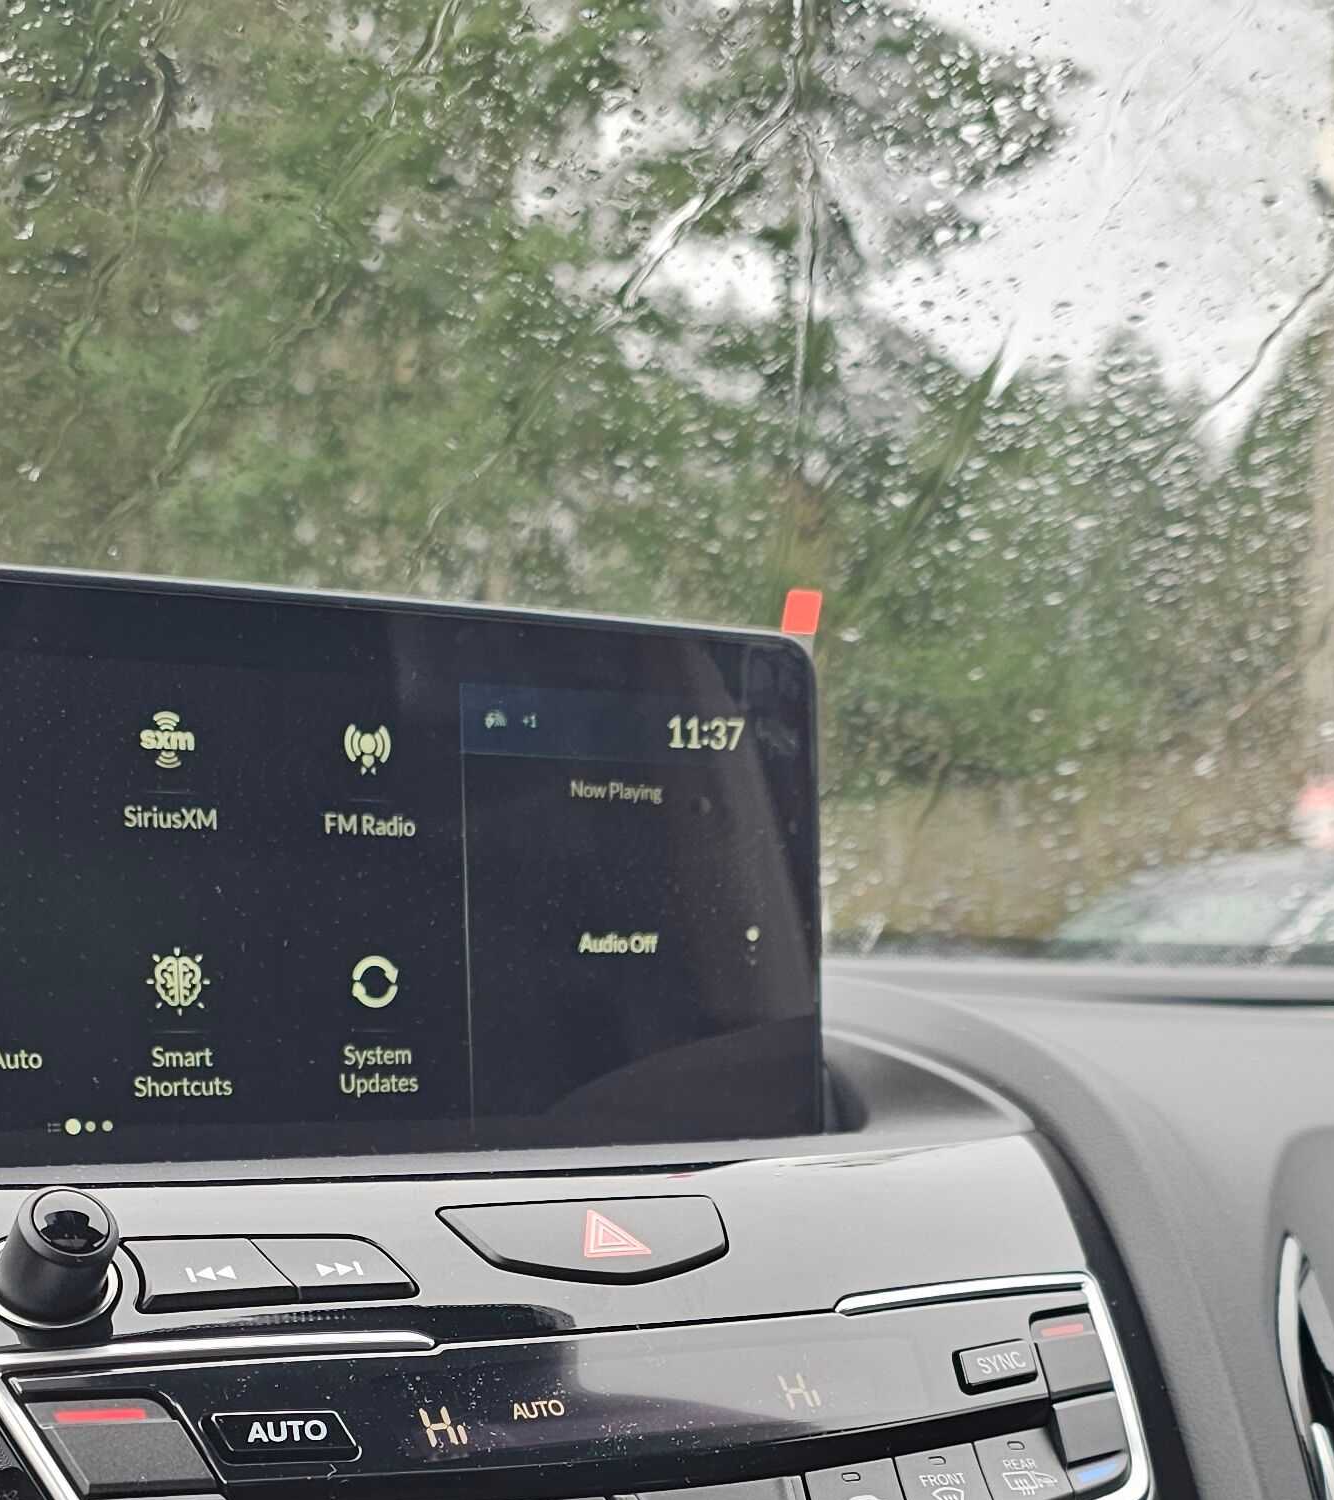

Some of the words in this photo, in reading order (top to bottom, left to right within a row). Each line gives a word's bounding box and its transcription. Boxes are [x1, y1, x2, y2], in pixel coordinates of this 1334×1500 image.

[140, 729, 195, 751] sxm
[668, 714, 745, 751] 11:37
[571, 780, 606, 799] Now
[609, 782, 663, 804] Playing
[124, 805, 217, 830] SiriusXM
[324, 813, 358, 836] FM
[362, 814, 416, 838] Radio
[578, 932, 627, 954] Audio
[630, 932, 659, 954] Off
[151, 1046, 213, 1069] Smart
[343, 1045, 412, 1069] System
[133, 1076, 233, 1099] Shortcuts
[340, 1072, 419, 1097] Updates
[976, 1351, 1026, 1375] SYNC
[513, 1400, 565, 1421] AUTO
[247, 1420, 327, 1443] AUTO
[1003, 1458, 1037, 1472] REAR
[919, 1471, 966, 1489] FRONT
